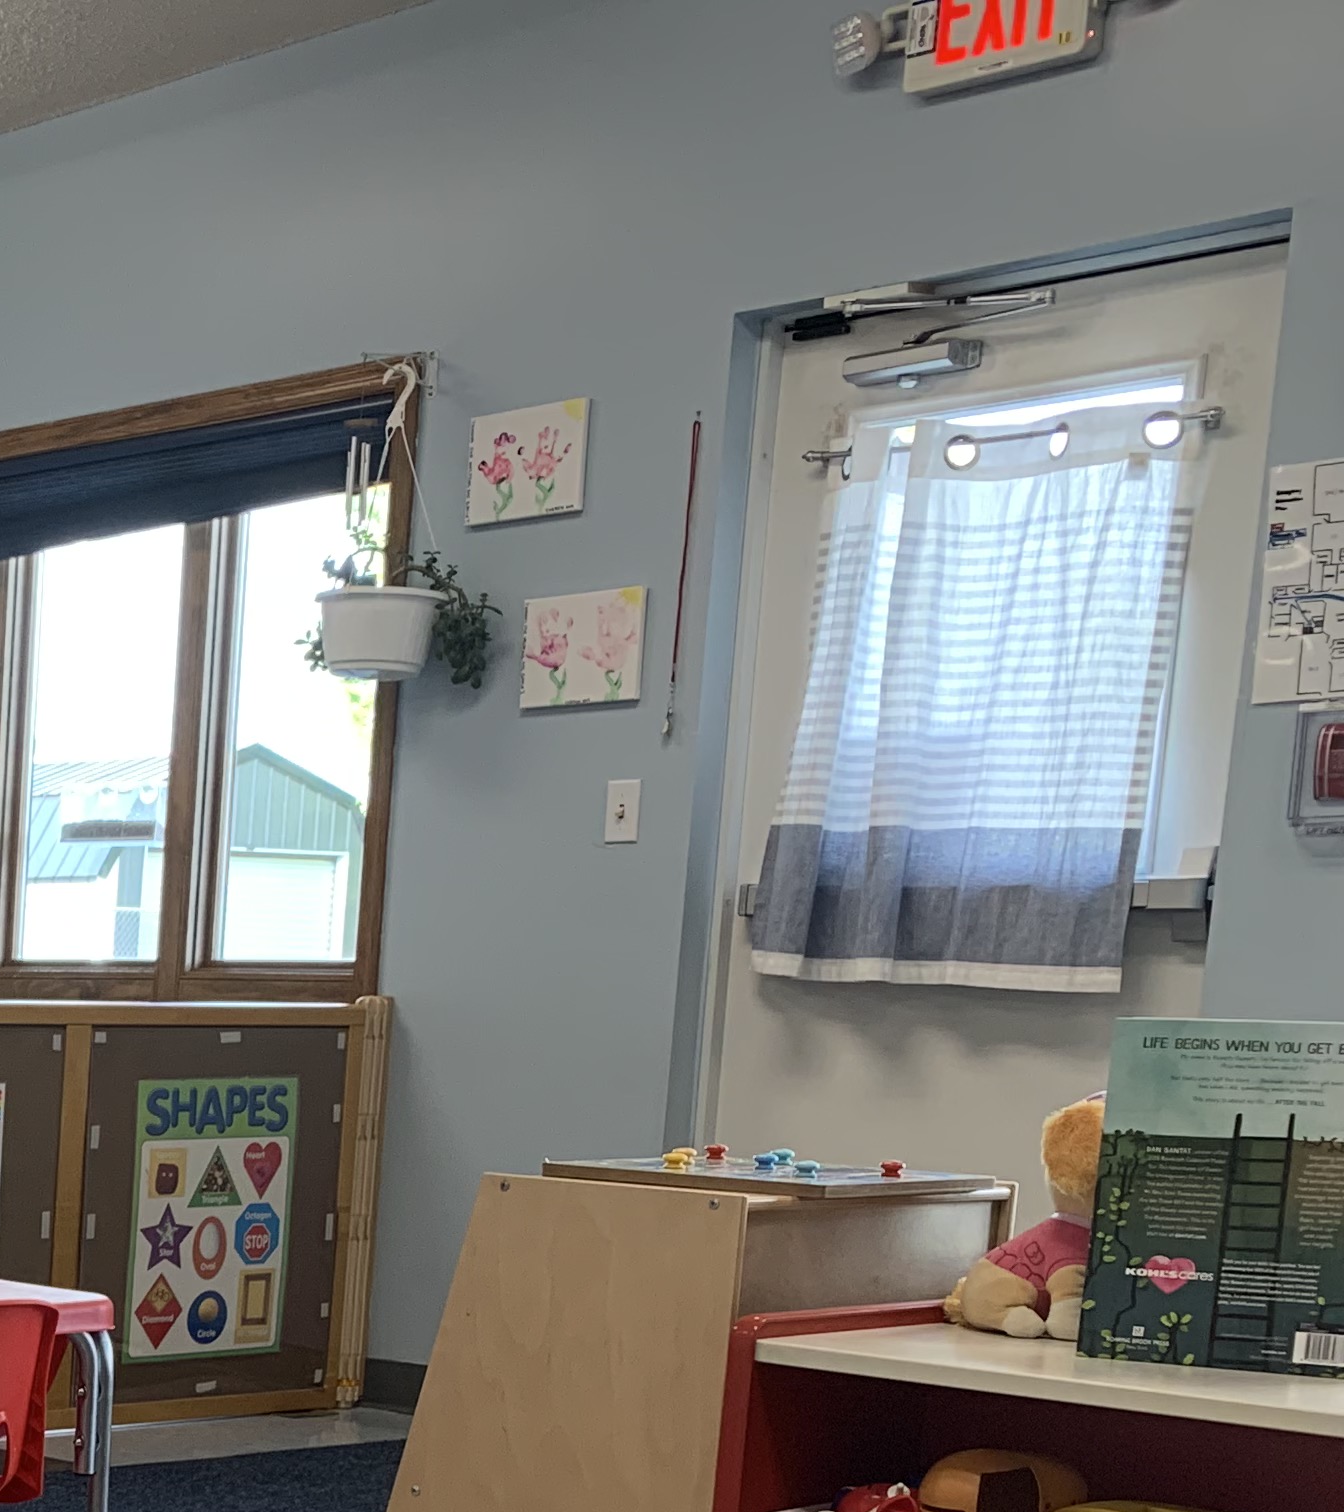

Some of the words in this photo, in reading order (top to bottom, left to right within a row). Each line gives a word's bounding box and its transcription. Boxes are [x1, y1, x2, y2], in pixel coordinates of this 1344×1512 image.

[1143, 1036, 1169, 1049] LIFE
[1174, 1038, 1220, 1051] BEGINS
[1225, 1040, 1270, 1052] WHEN
[1275, 1041, 1302, 1053] YOU
[1307, 1042, 1333, 1055] GET
[145, 1084, 289, 1136] SHAPES
[245, 1150, 266, 1160] Heart
[244, 1210, 272, 1221] Octagon
[244, 1233, 269, 1250] STOP
[158, 1247, 174, 1258] Star
[200, 1261, 216, 1272] Oval
[1178, 1271, 1214, 1282] cares
[141, 1312, 175, 1325] Diamond
[196, 1329, 217, 1339] Circle
